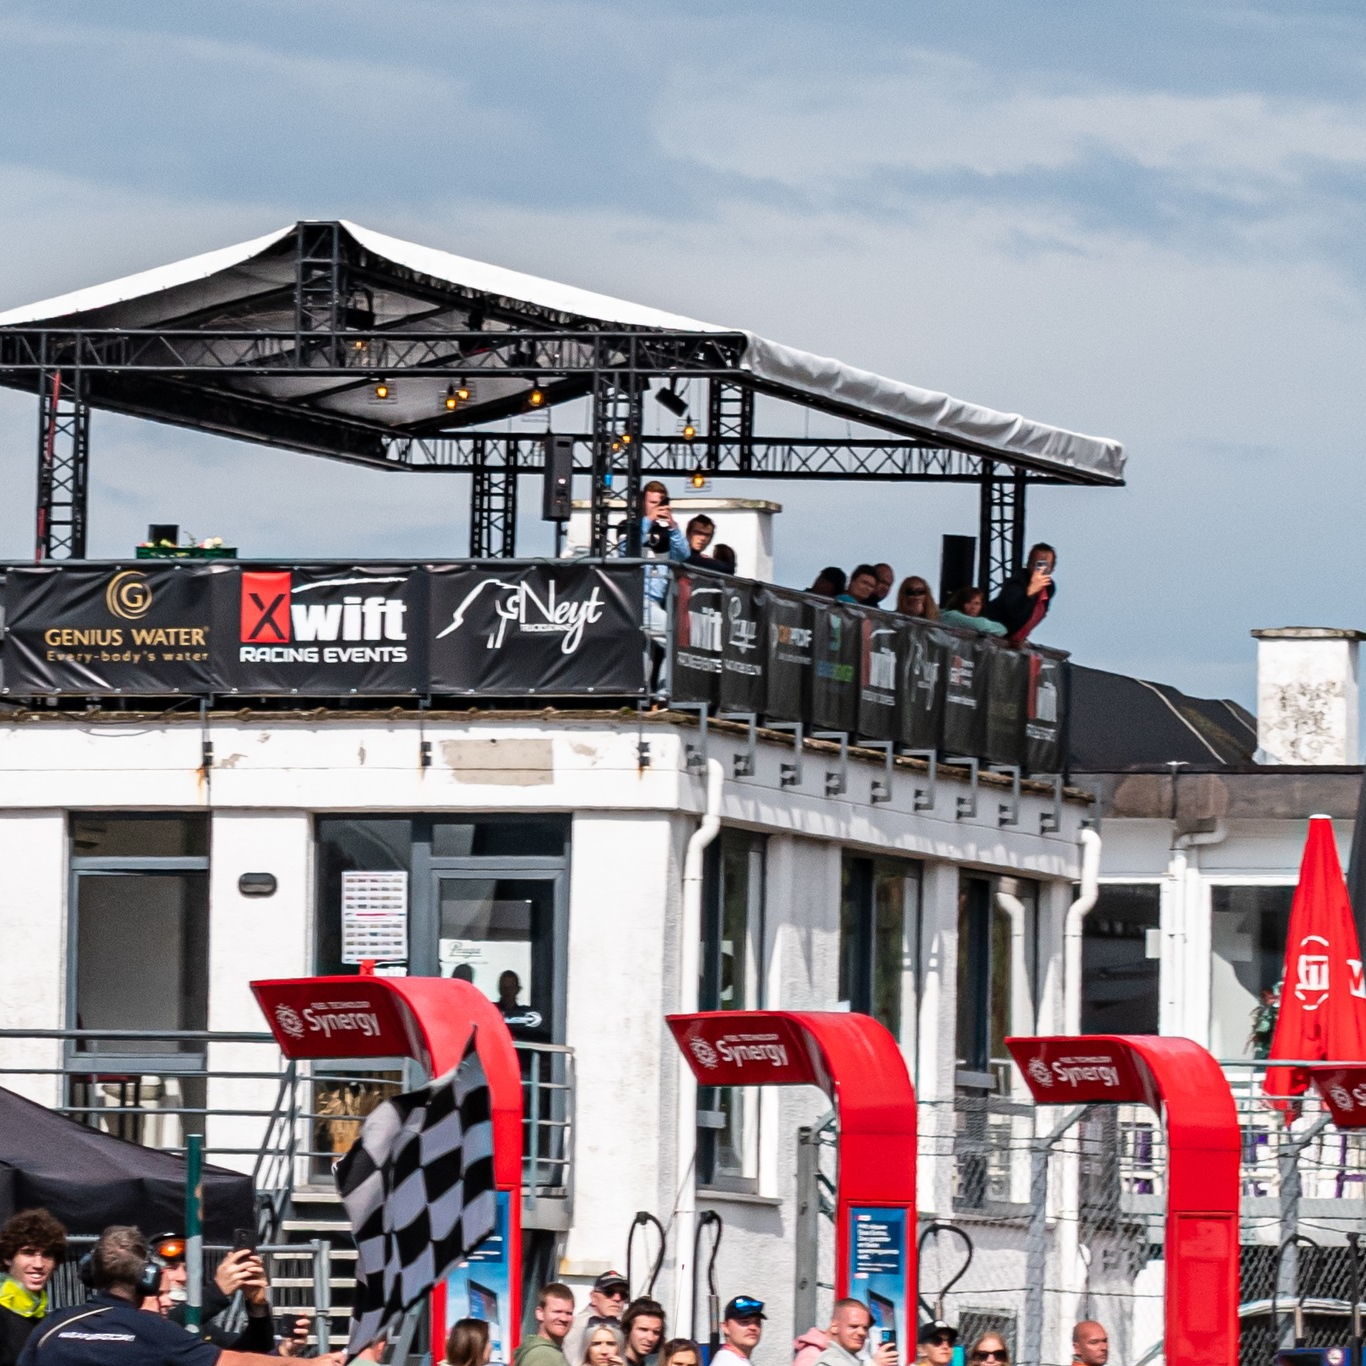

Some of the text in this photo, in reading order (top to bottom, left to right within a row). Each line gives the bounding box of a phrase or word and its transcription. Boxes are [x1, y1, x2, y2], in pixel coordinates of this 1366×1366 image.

[247, 593, 408, 642] Xwift
[44, 628, 206, 646] GENIUS WATER
[46, 650, 210, 663] Every-body's water
[239, 646, 408, 664] RACING EVENTS
[303, 1008, 381, 1038] Synergy
[716, 1039, 789, 1068] Synergy
[1052, 1061, 1120, 1087] Synergy
